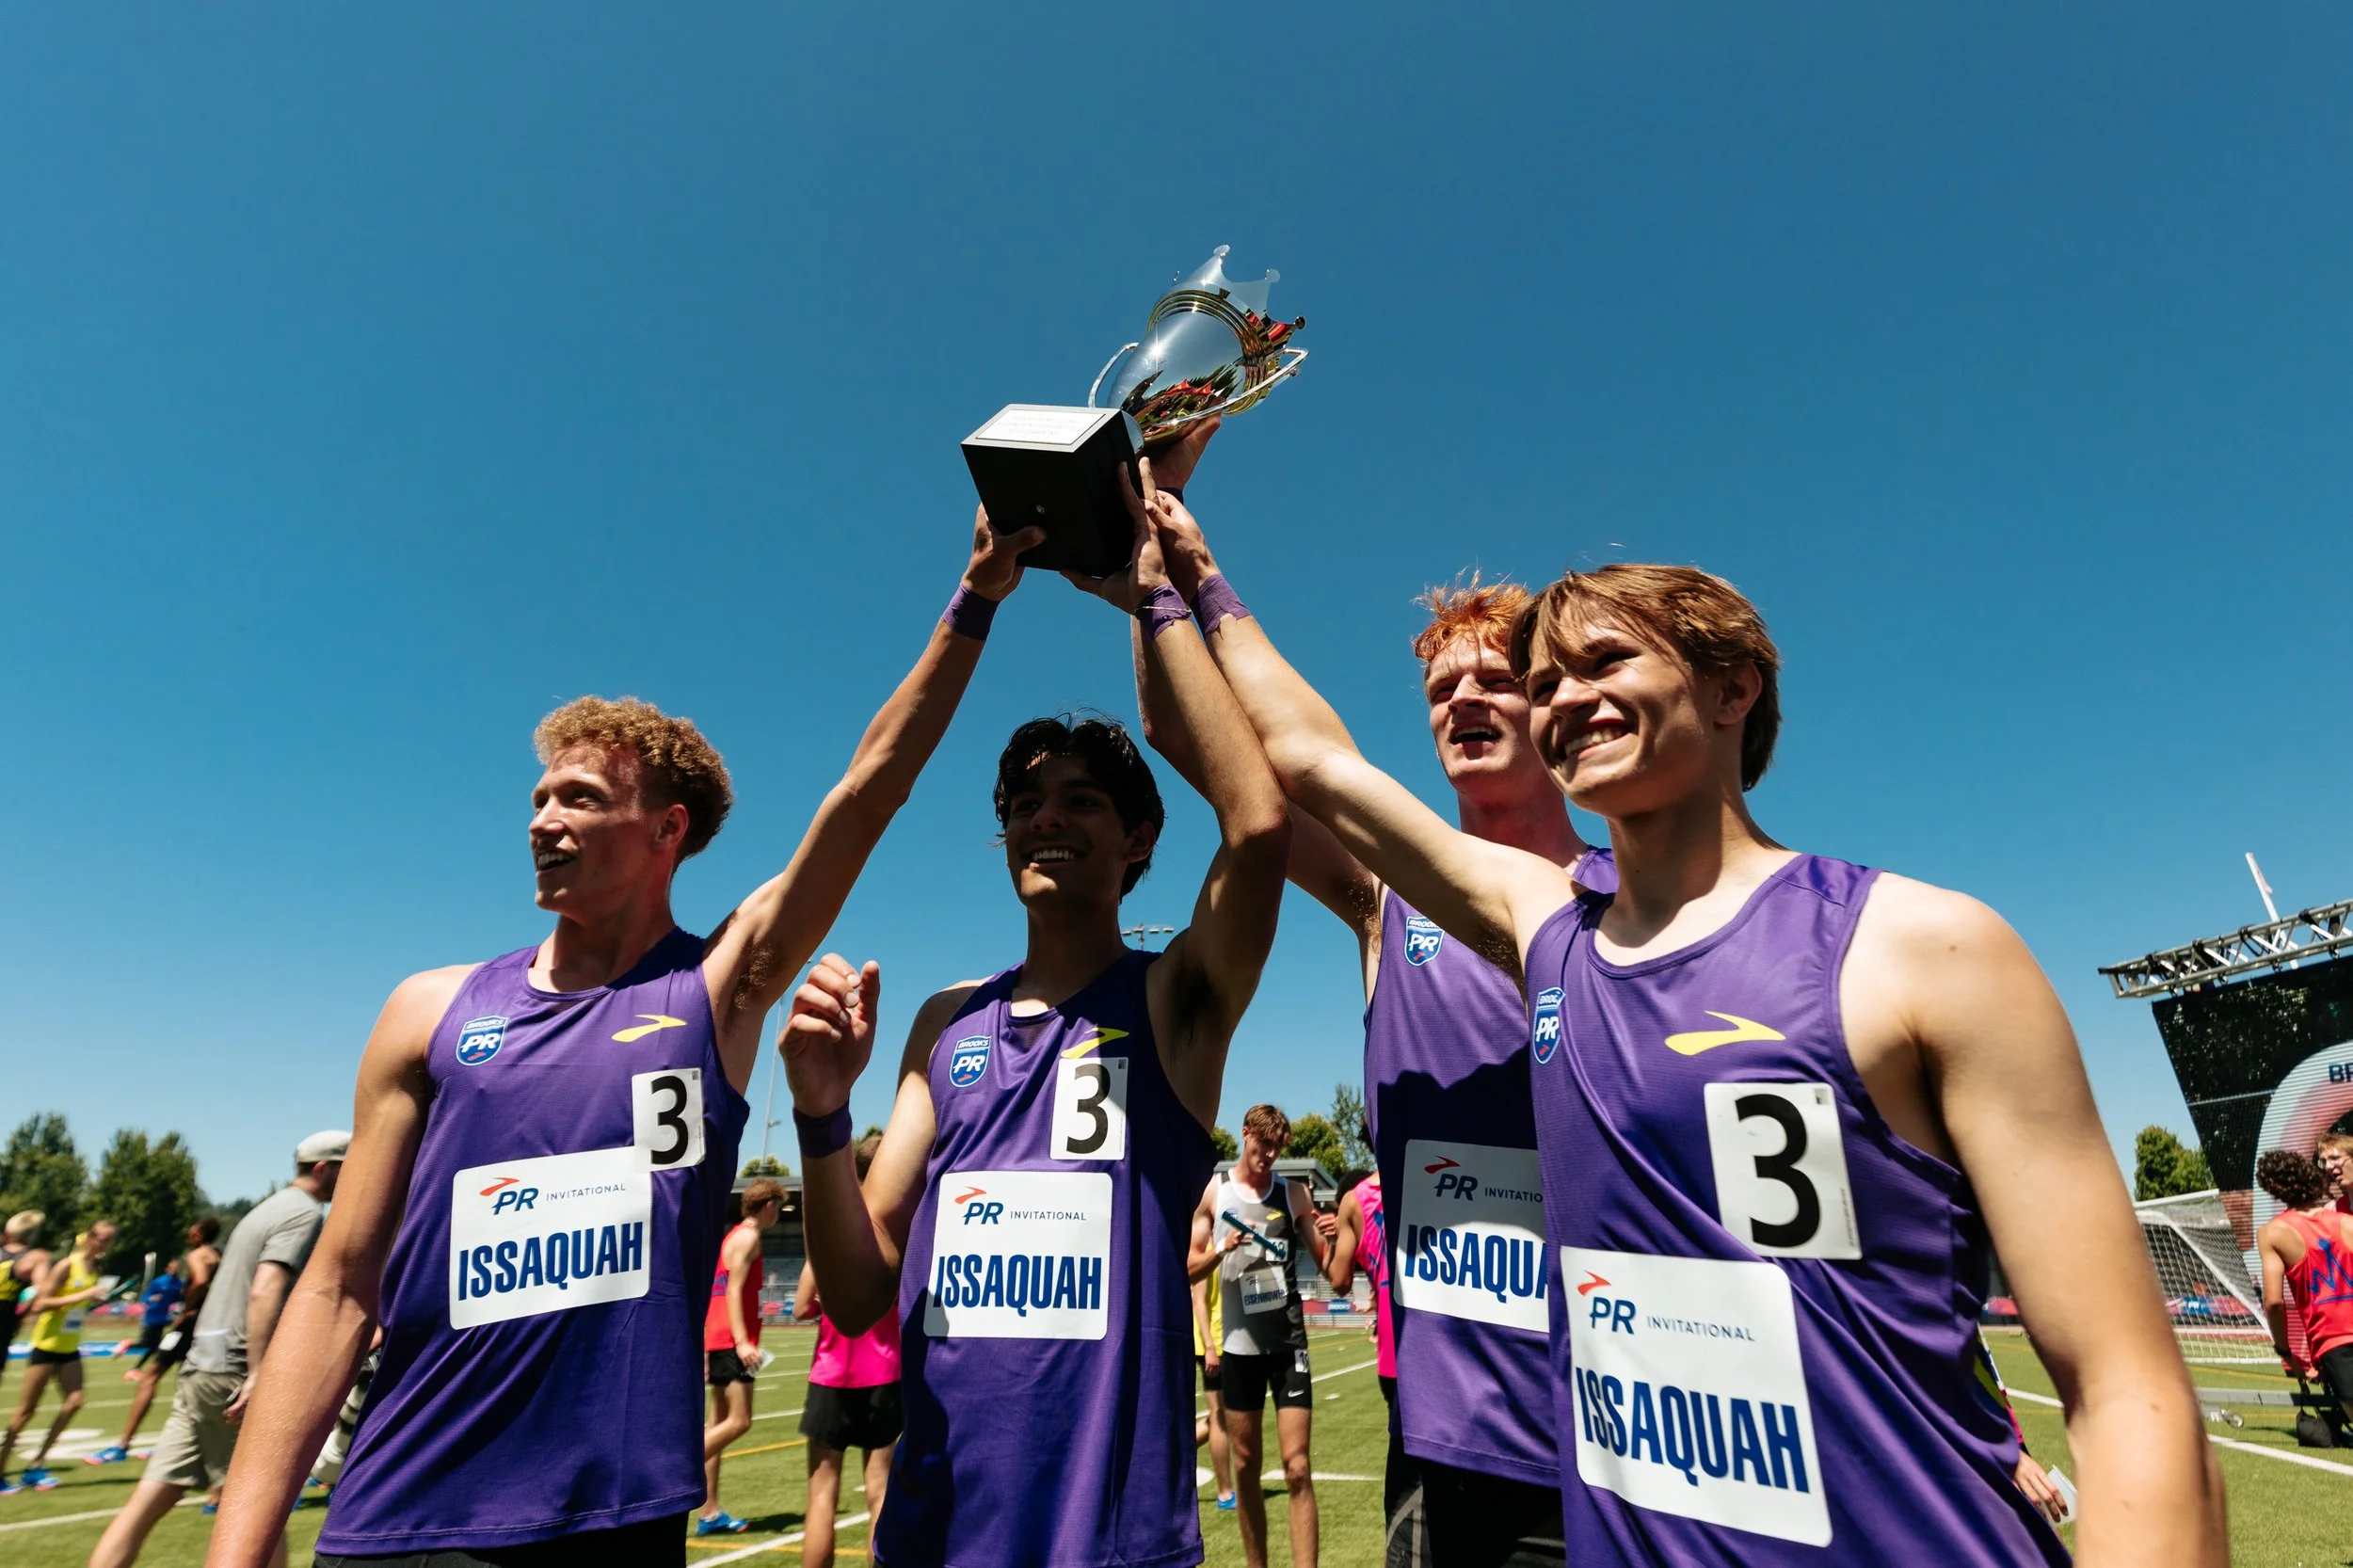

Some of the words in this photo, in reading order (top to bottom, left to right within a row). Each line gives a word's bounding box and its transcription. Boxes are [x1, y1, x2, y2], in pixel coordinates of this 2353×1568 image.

[1409, 919, 1439, 928] BROO
[1408, 933, 1439, 952] PR
[460, 1033, 501, 1052] PR
[958, 1039, 989, 1048] BROOKS
[1536, 1016, 1560, 1042] PR
[952, 1055, 985, 1073] PR
[650, 1076, 689, 1165] 3
[1066, 1064, 1112, 1154] 3
[1735, 1094, 1820, 1248] 3
[490, 1188, 538, 1215] PR
[546, 1183, 626, 1202] INVITATIONAL
[1434, 1174, 1478, 1201] PR
[1485, 1187, 1544, 1203] INVITATIO
[963, 1202, 1003, 1225] PR
[1010, 1210, 1087, 1222] INVITATIONAL
[458, 1221, 643, 1301] ISSAQUAH
[1404, 1224, 1548, 1304] ISSAQUA
[933, 1254, 1102, 1318] ISSAQUAH
[1590, 1296, 1636, 1335] PR
[1647, 1315, 1756, 1342] INVITATIONAL
[1576, 1367, 1810, 1494] ISSAQUAH
